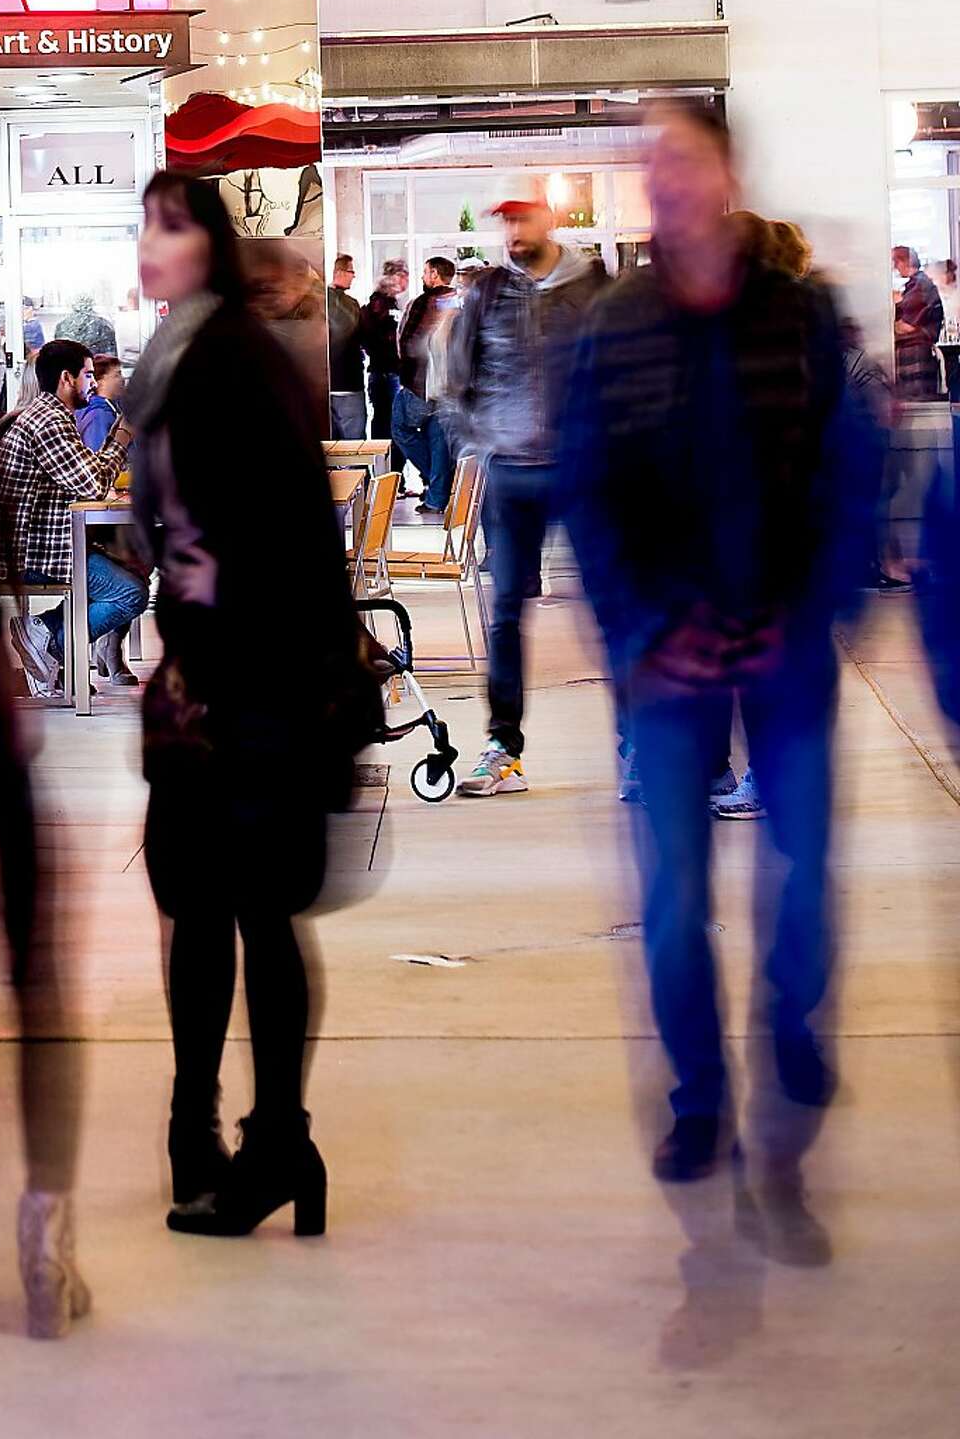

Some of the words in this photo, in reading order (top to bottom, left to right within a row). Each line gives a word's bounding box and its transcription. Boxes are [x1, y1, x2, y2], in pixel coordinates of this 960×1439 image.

[37, 30, 60, 55] &
[67, 28, 173, 58] History
[47, 164, 114, 185] ALL
